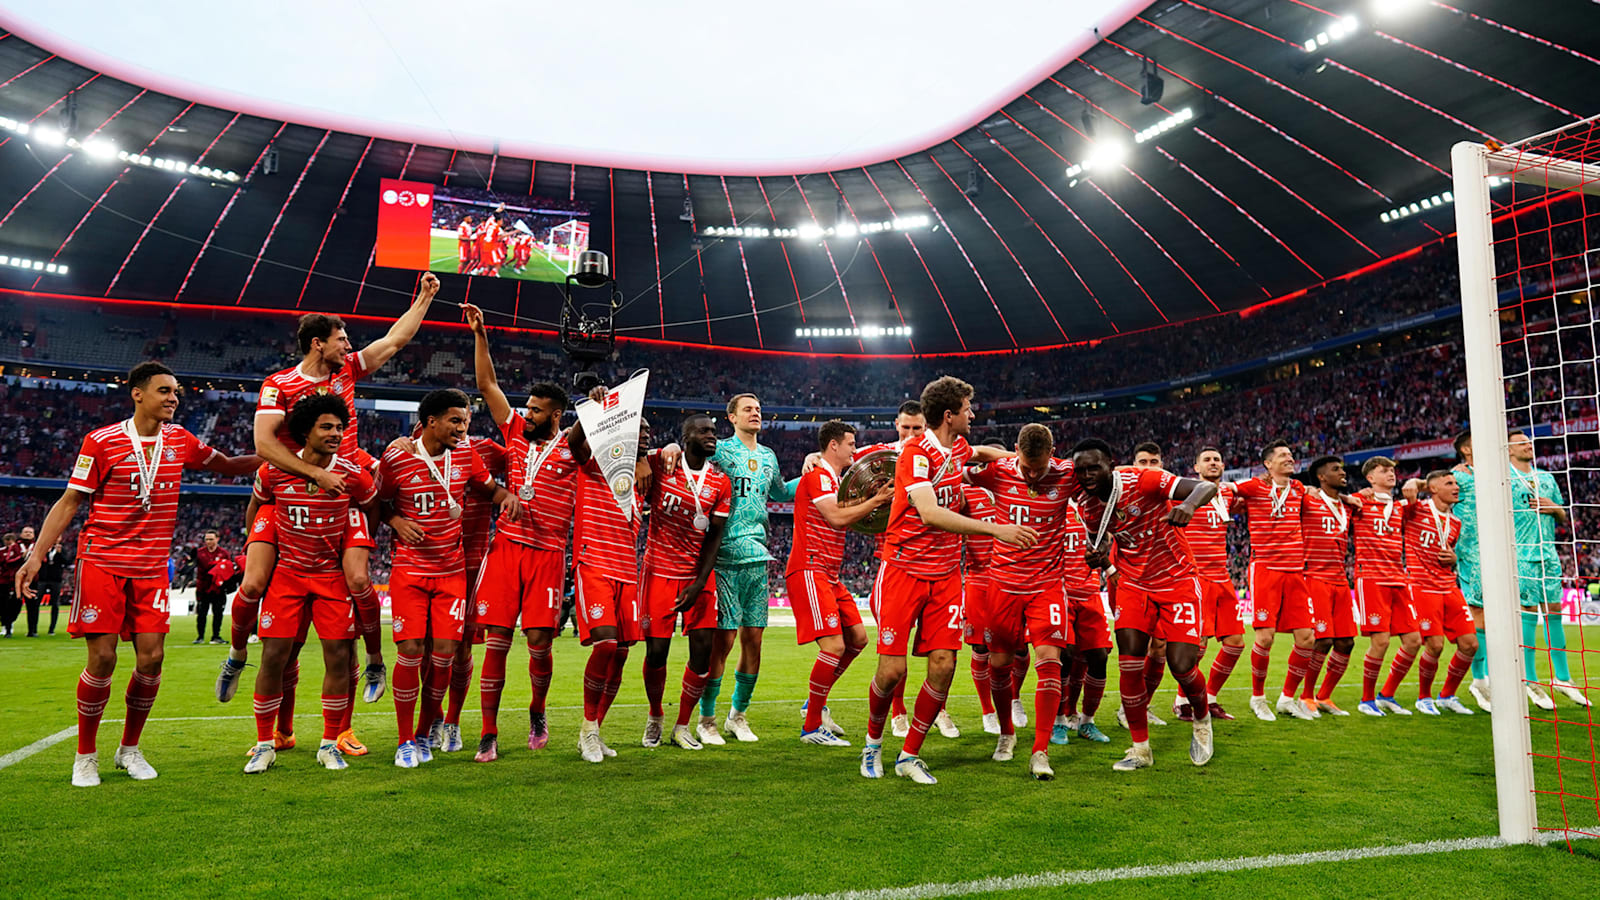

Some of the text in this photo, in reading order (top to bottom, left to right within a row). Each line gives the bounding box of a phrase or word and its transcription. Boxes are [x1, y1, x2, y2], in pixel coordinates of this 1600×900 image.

[597, 410, 628, 427] DEUTSCHER
[414, 492, 435, 515] T
[288, 505, 309, 530] T
[348, 508, 361, 527] 8
[449, 598, 466, 621] 40
[547, 587, 561, 610] 13
[1049, 603, 1061, 625] 6
[1173, 603, 1196, 624] 23
